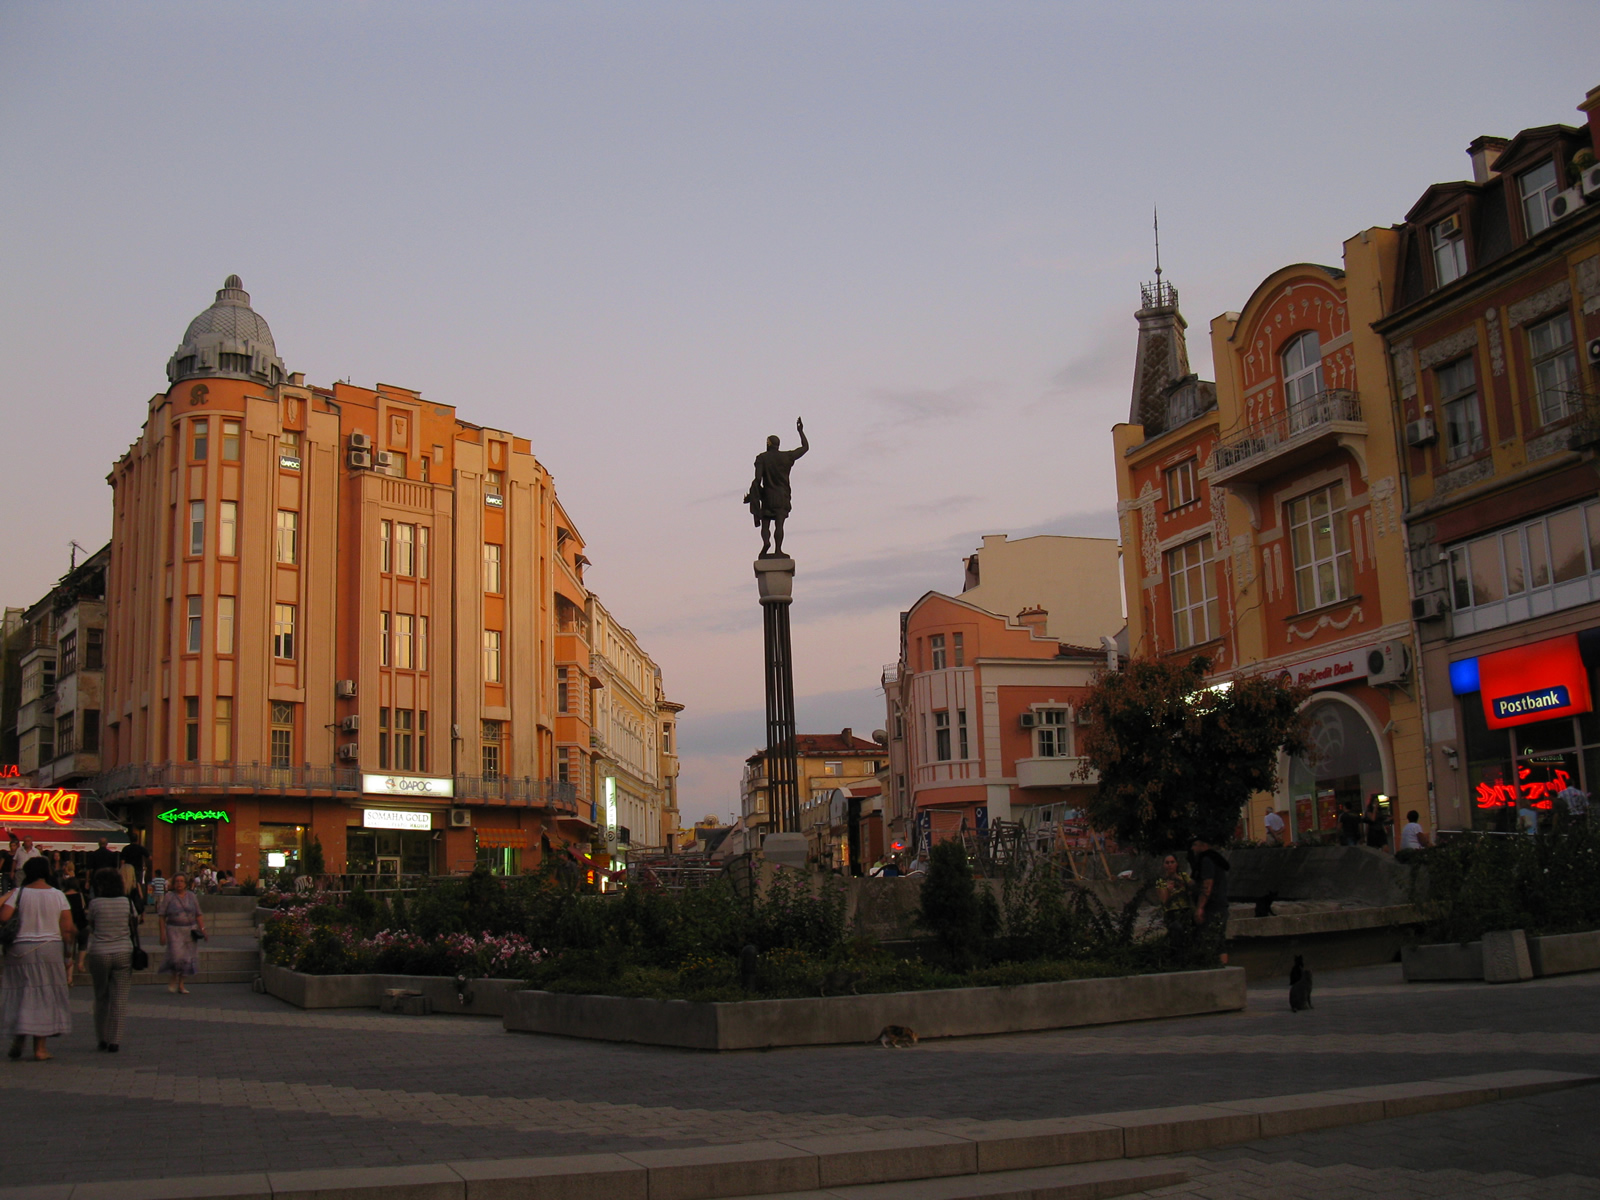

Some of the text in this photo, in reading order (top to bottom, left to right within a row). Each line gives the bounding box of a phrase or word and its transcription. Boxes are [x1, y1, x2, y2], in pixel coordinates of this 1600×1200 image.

[1333, 660, 1354, 677] Bank
[1500, 691, 1560, 715] Postbank
[399, 777, 432, 792] ФАРОС
[367, 811, 429, 823] SOMAHA GOLD
